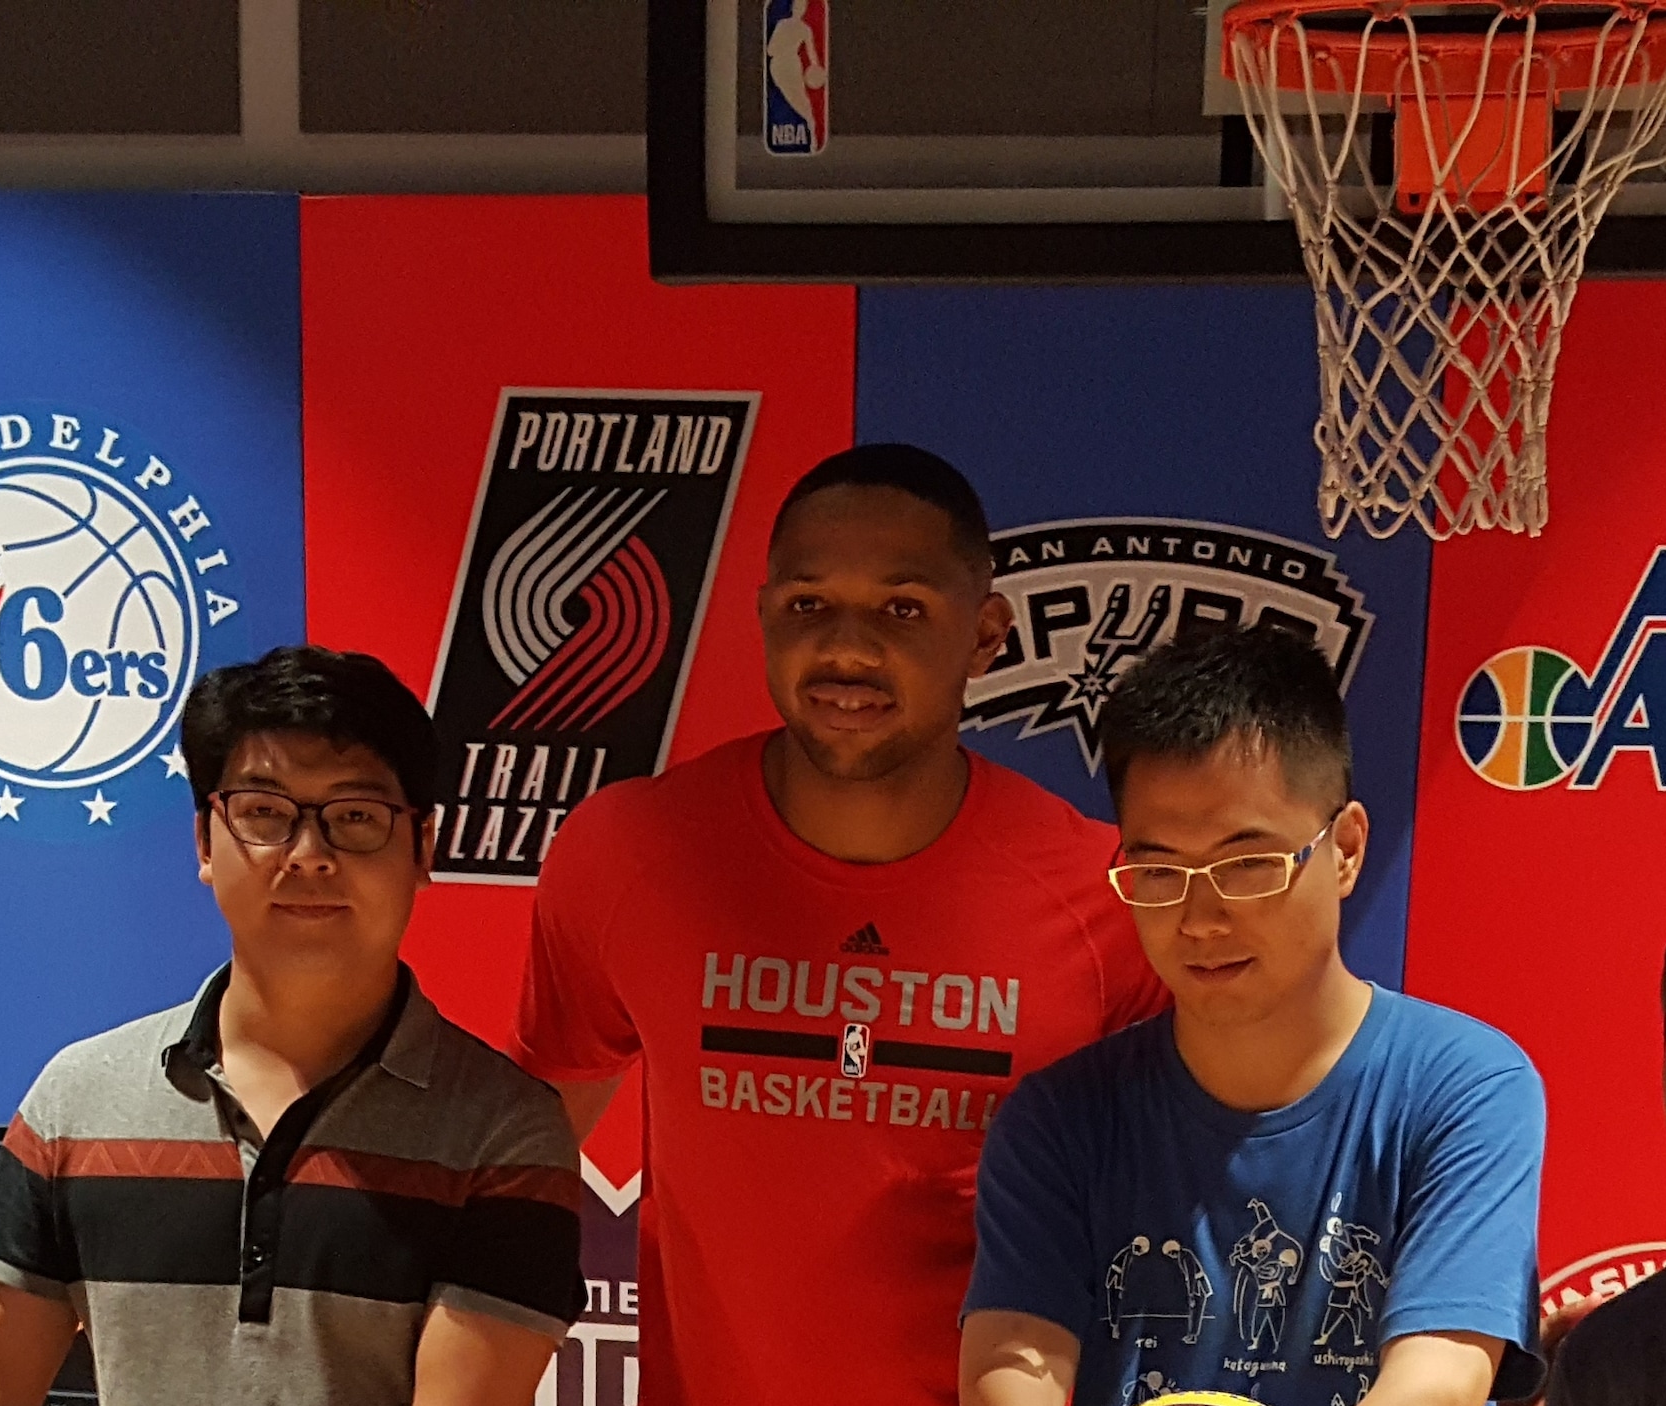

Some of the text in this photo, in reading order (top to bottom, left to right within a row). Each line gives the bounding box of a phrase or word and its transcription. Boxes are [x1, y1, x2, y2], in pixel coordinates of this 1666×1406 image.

[771, 123, 809, 146] NBA
[508, 411, 733, 476] PORTLAND
[990, 535, 1309, 582] AN ANTONIO
[701, 951, 1021, 1036] HOUSTON
